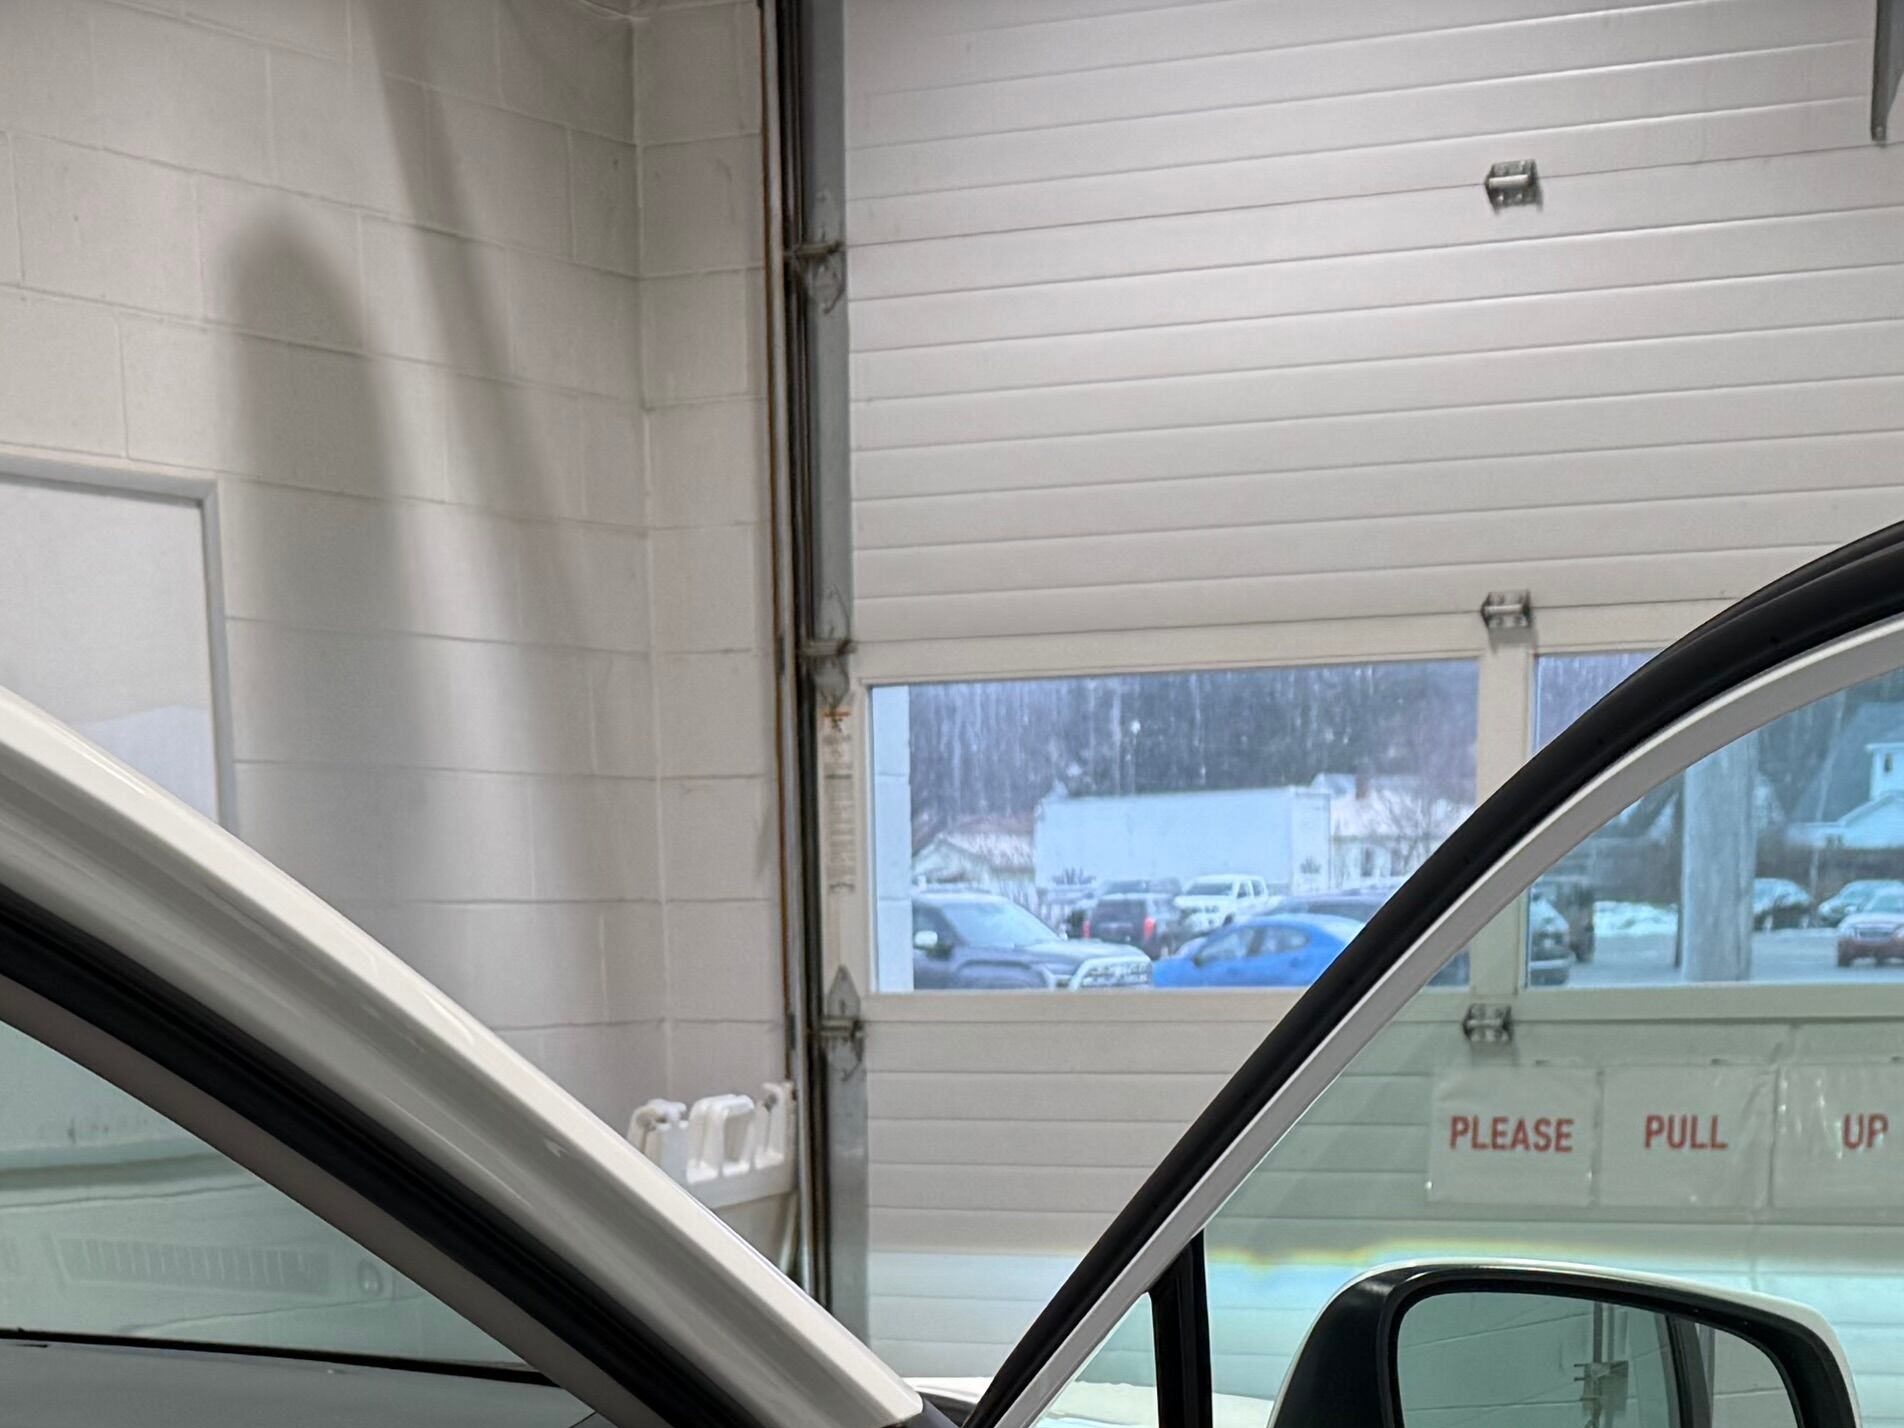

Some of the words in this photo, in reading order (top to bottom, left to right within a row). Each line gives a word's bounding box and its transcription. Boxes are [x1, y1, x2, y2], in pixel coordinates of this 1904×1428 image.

[1449, 1114, 1575, 1153] PLEASE
[1644, 1114, 1728, 1151] PULL
[1842, 1114, 1889, 1149] UP
